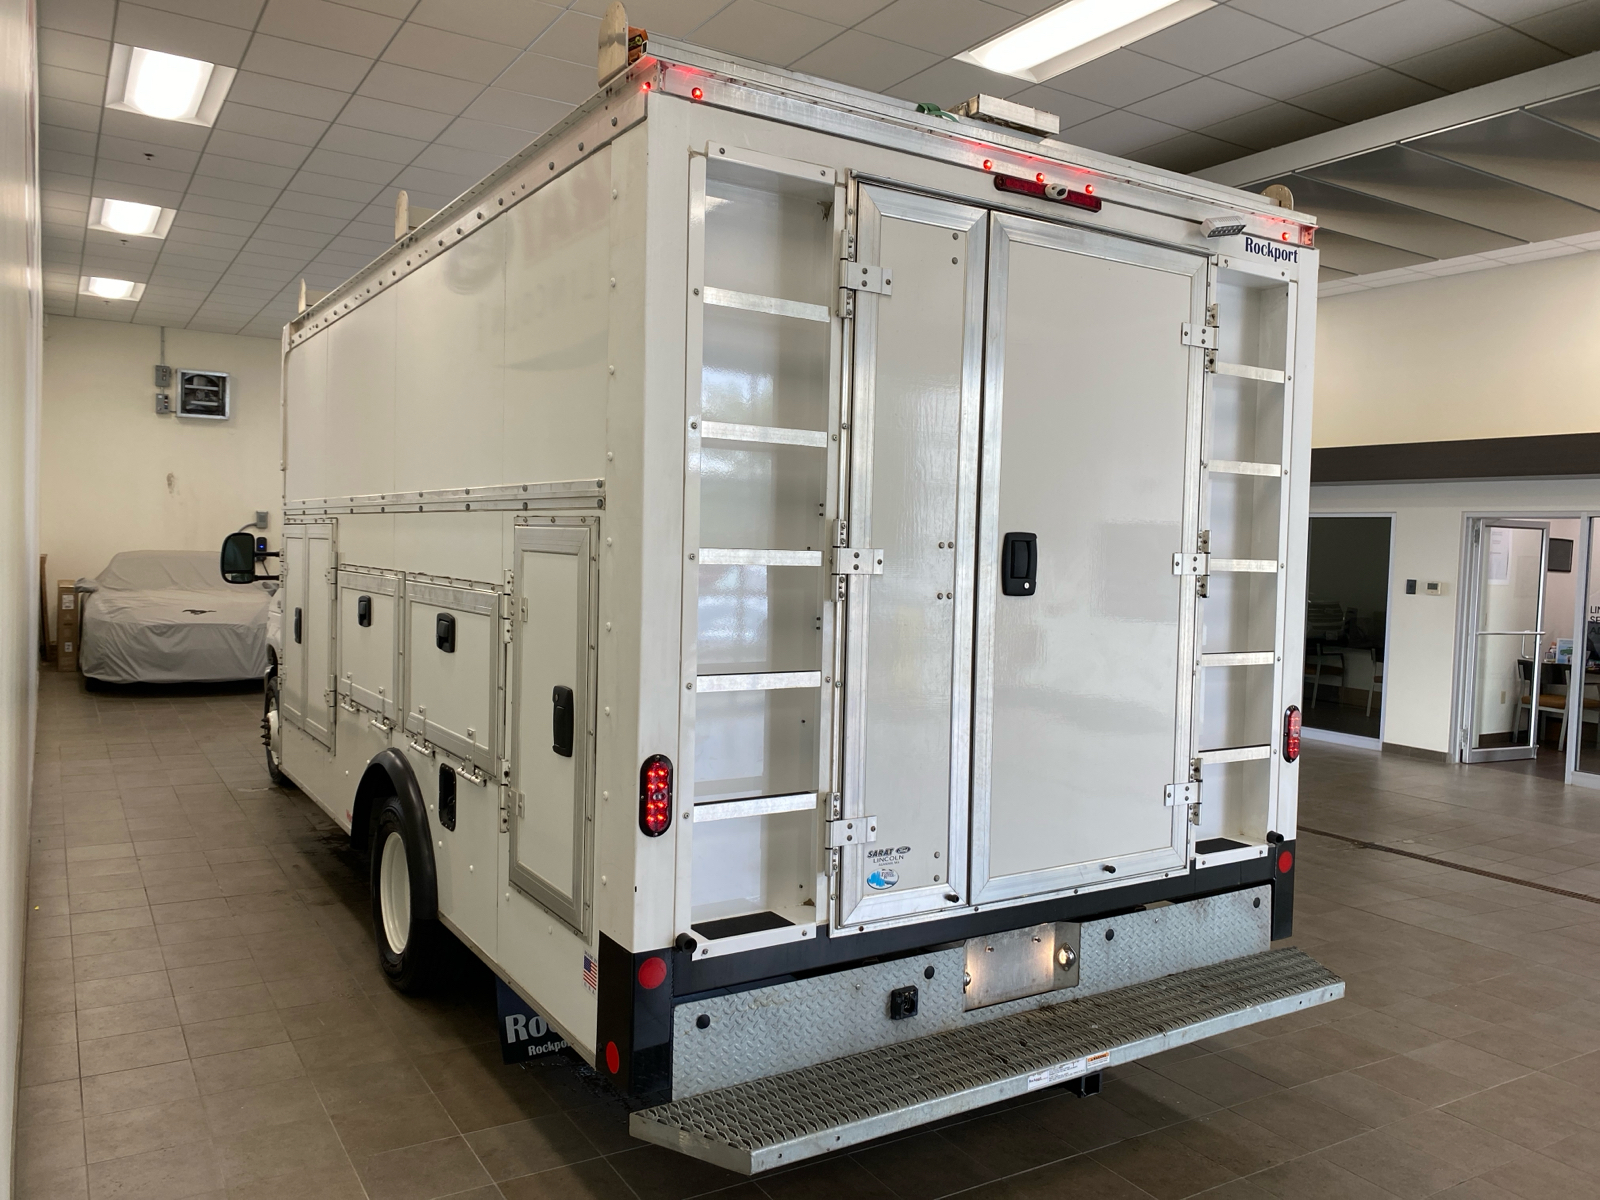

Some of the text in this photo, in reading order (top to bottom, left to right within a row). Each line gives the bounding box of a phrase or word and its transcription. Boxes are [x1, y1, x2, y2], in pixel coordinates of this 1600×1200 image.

[1245, 236, 1298, 263] Rockport
[867, 848, 895, 858] SARAT
[873, 855, 904, 863] LINCOLN
